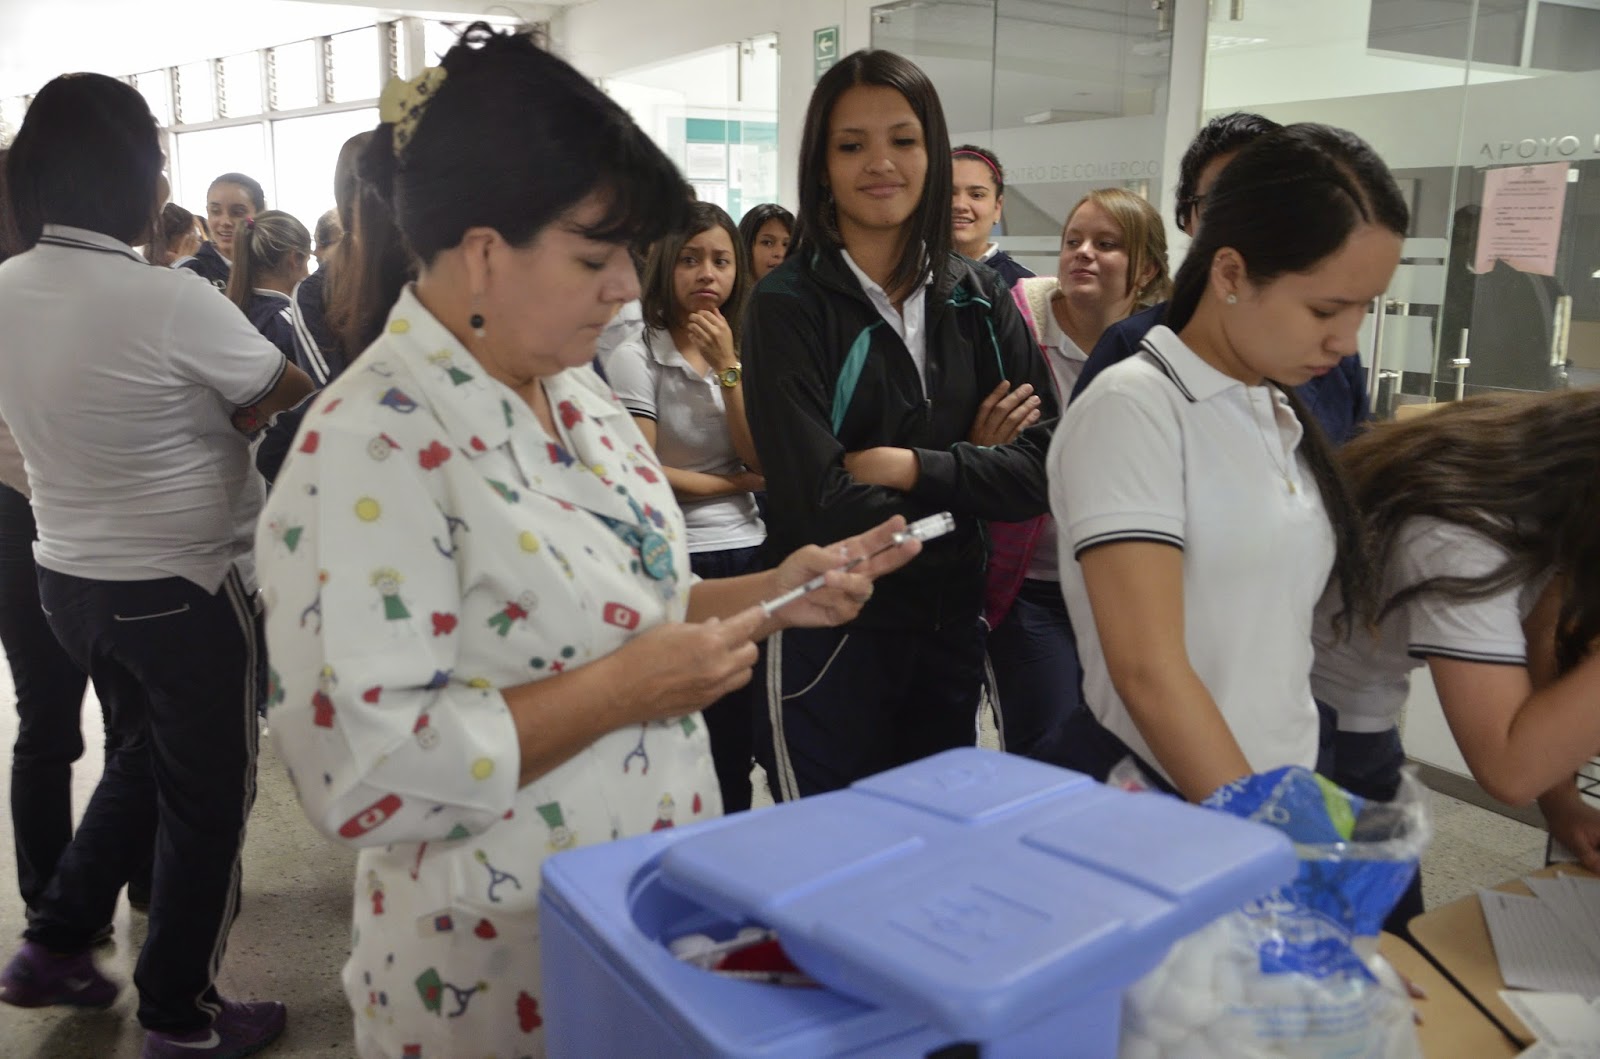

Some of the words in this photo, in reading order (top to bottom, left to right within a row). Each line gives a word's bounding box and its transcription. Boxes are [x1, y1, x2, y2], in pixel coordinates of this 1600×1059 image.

[1480, 135, 1580, 160] APOYO
[1003, 165, 1046, 182] ENTRO
[1050, 163, 1071, 180] DE
[1073, 160, 1159, 178] COMERCIO
